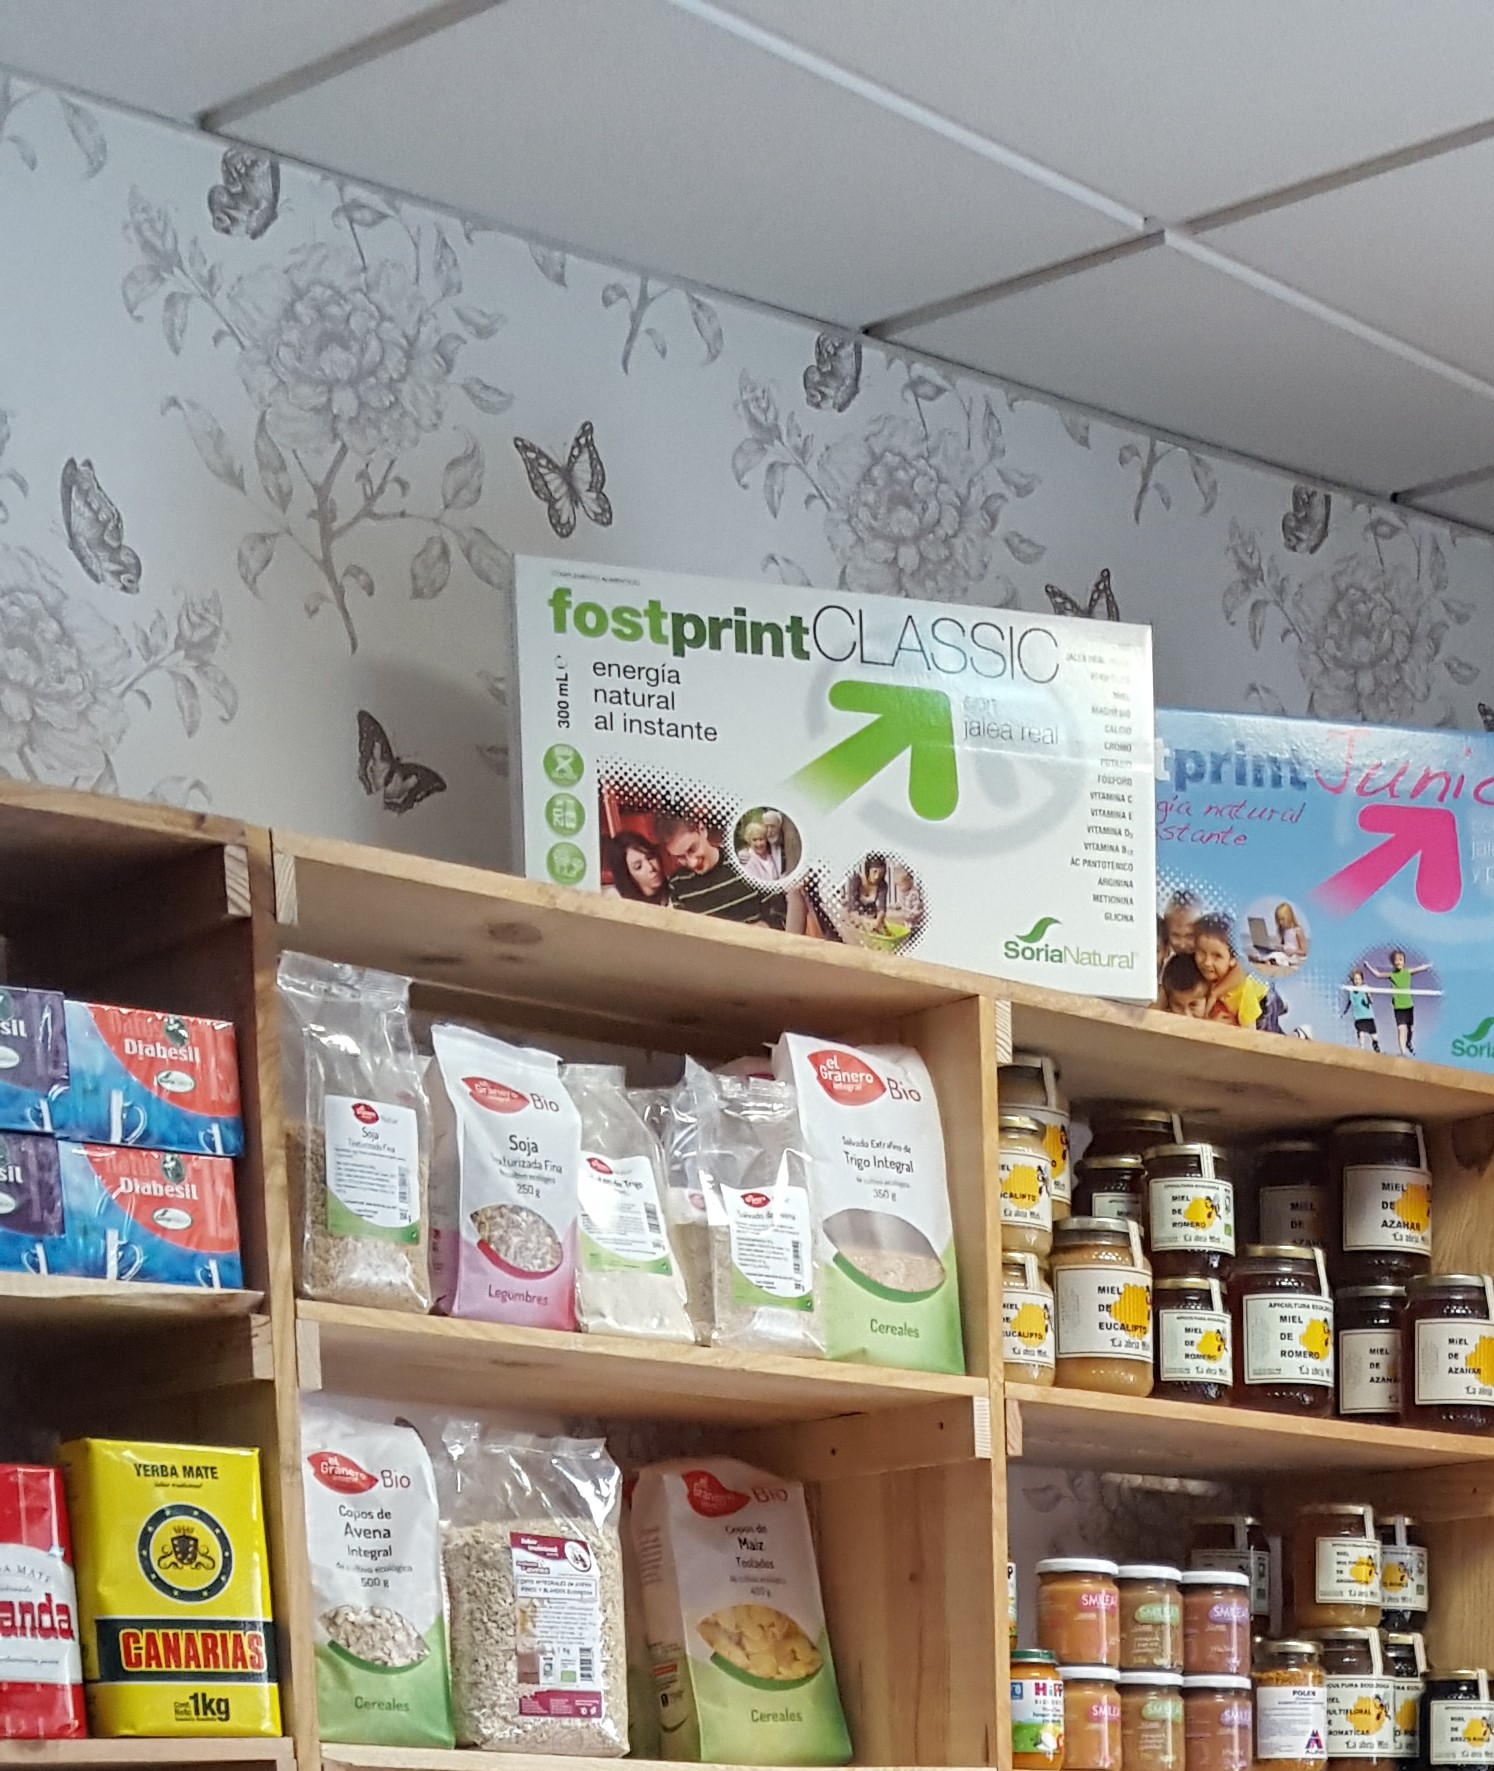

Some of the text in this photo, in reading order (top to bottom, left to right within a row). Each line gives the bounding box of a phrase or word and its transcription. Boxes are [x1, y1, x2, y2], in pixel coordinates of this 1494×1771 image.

[592, 661, 681, 687] energía
[593, 688, 676, 711] natural
[594, 713, 718, 742] al instante
[963, 719, 1060, 745] jalea real
[1204, 799, 1306, 825] natural
[124, 1037, 200, 1064] Diabesil
[819, 1066, 874, 1084] Granero
[886, 1076, 922, 1103] Bio
[531, 1094, 560, 1113] Bio
[508, 1134, 539, 1157] Soja
[844, 1151, 914, 1174] Trigo Integral
[119, 1176, 198, 1201] Diabesil
[488, 1284, 550, 1307] Legumbres
[1097, 1286, 1121, 1295] MIEL
[1098, 1303, 1112, 1313] DE
[870, 1318, 920, 1339] Cereales
[1098, 1321, 1148, 1335] EUCALIPTO
[1279, 1315, 1304, 1324] MIEL
[1280, 1331, 1294, 1341] DE
[1280, 1349, 1320, 1361] ROMERO
[134, 1462, 220, 1480] YERBA MATE
[381, 1469, 412, 1489] Bio
[343, 1522, 392, 1540] Avena
[346, 1546, 393, 1559] Integral
[120, 1627, 268, 1672] CANARIAS
[189, 1692, 231, 1722] 1kg
[354, 1696, 410, 1713] Cereales
[751, 1708, 804, 1723] Cereales
